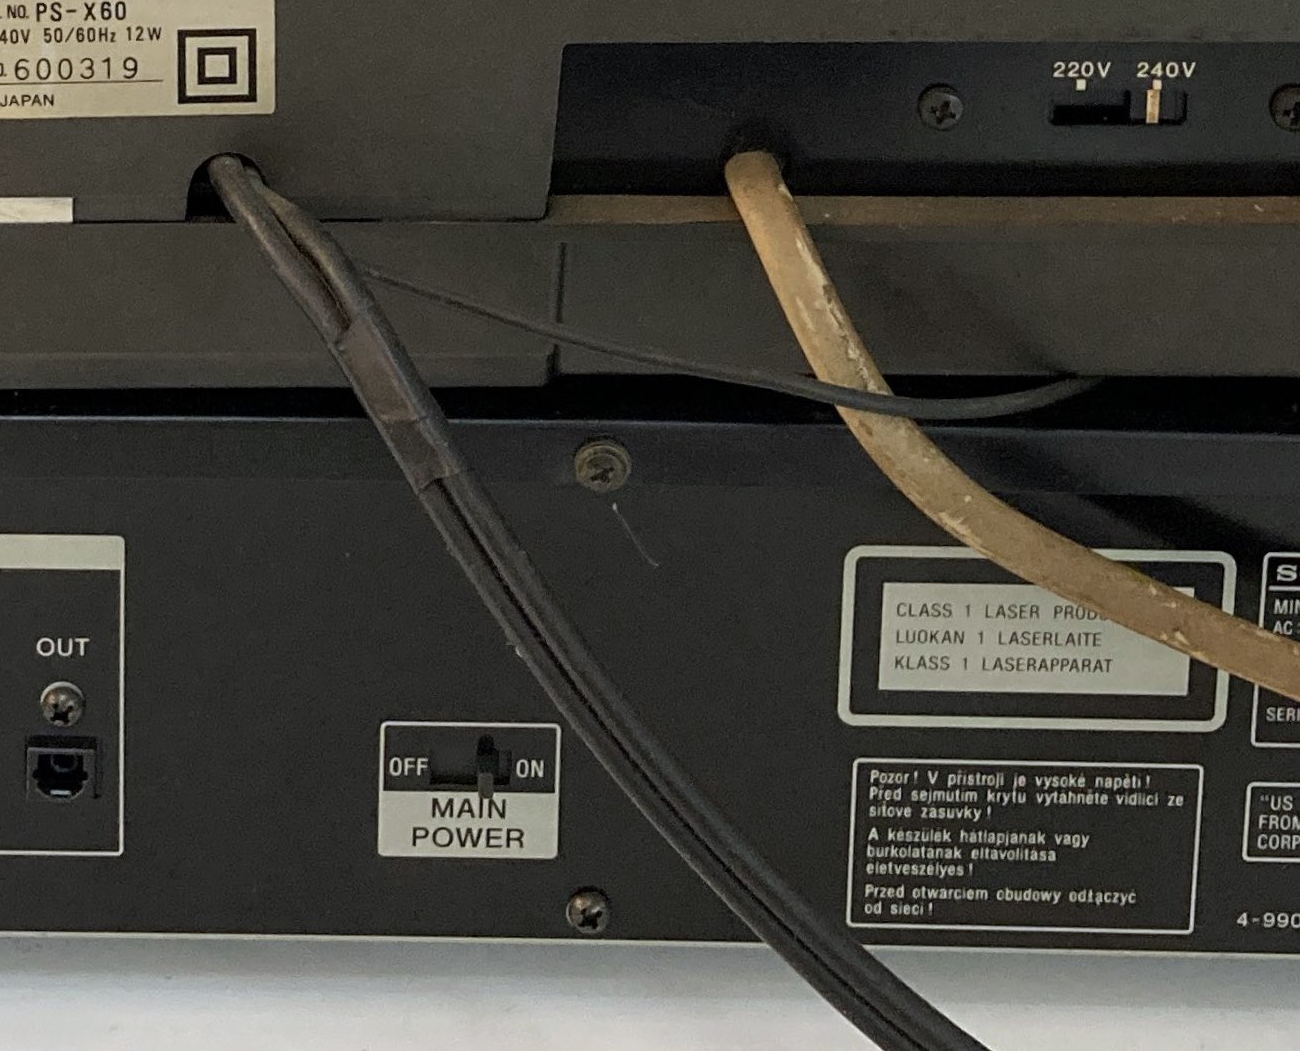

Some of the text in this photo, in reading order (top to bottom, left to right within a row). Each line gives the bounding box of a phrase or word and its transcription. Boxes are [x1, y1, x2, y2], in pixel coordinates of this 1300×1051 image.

[6, 3, 29, 21] NO.
[35, 1, 127, 23] PS-X60
[43, 27, 116, 44] 50/60Hz
[125, 26, 162, 42] 12W
[13, 56, 139, 82] 600319
[1052, 61, 1111, 78] 220V
[1136, 61, 1196, 78] 240V
[0, 93, 55, 109] JAPAN
[896, 603, 953, 618] CLASS
[965, 604, 971, 618] 1
[984, 604, 1040, 620] LASER
[36, 637, 90, 658] OUT
[895, 630, 1102, 648] LUOKAN 1 LASERLAITE
[894, 656, 1113, 674] KLASS 1 LASERAPPARAT
[389, 757, 428, 777] OFF
[516, 759, 544, 778] ON
[927, 770, 939, 784] V
[431, 797, 507, 820] MAIN
[1167, 795, 1184, 807] ze
[411, 826, 525, 849] POWER
[868, 827, 879, 841] A
[1054, 832, 1091, 848] vagy
[864, 884, 905, 899] Przed
[912, 885, 989, 901] otwarciem
[996, 887, 1062, 905] obudowy
[864, 900, 883, 915] od
